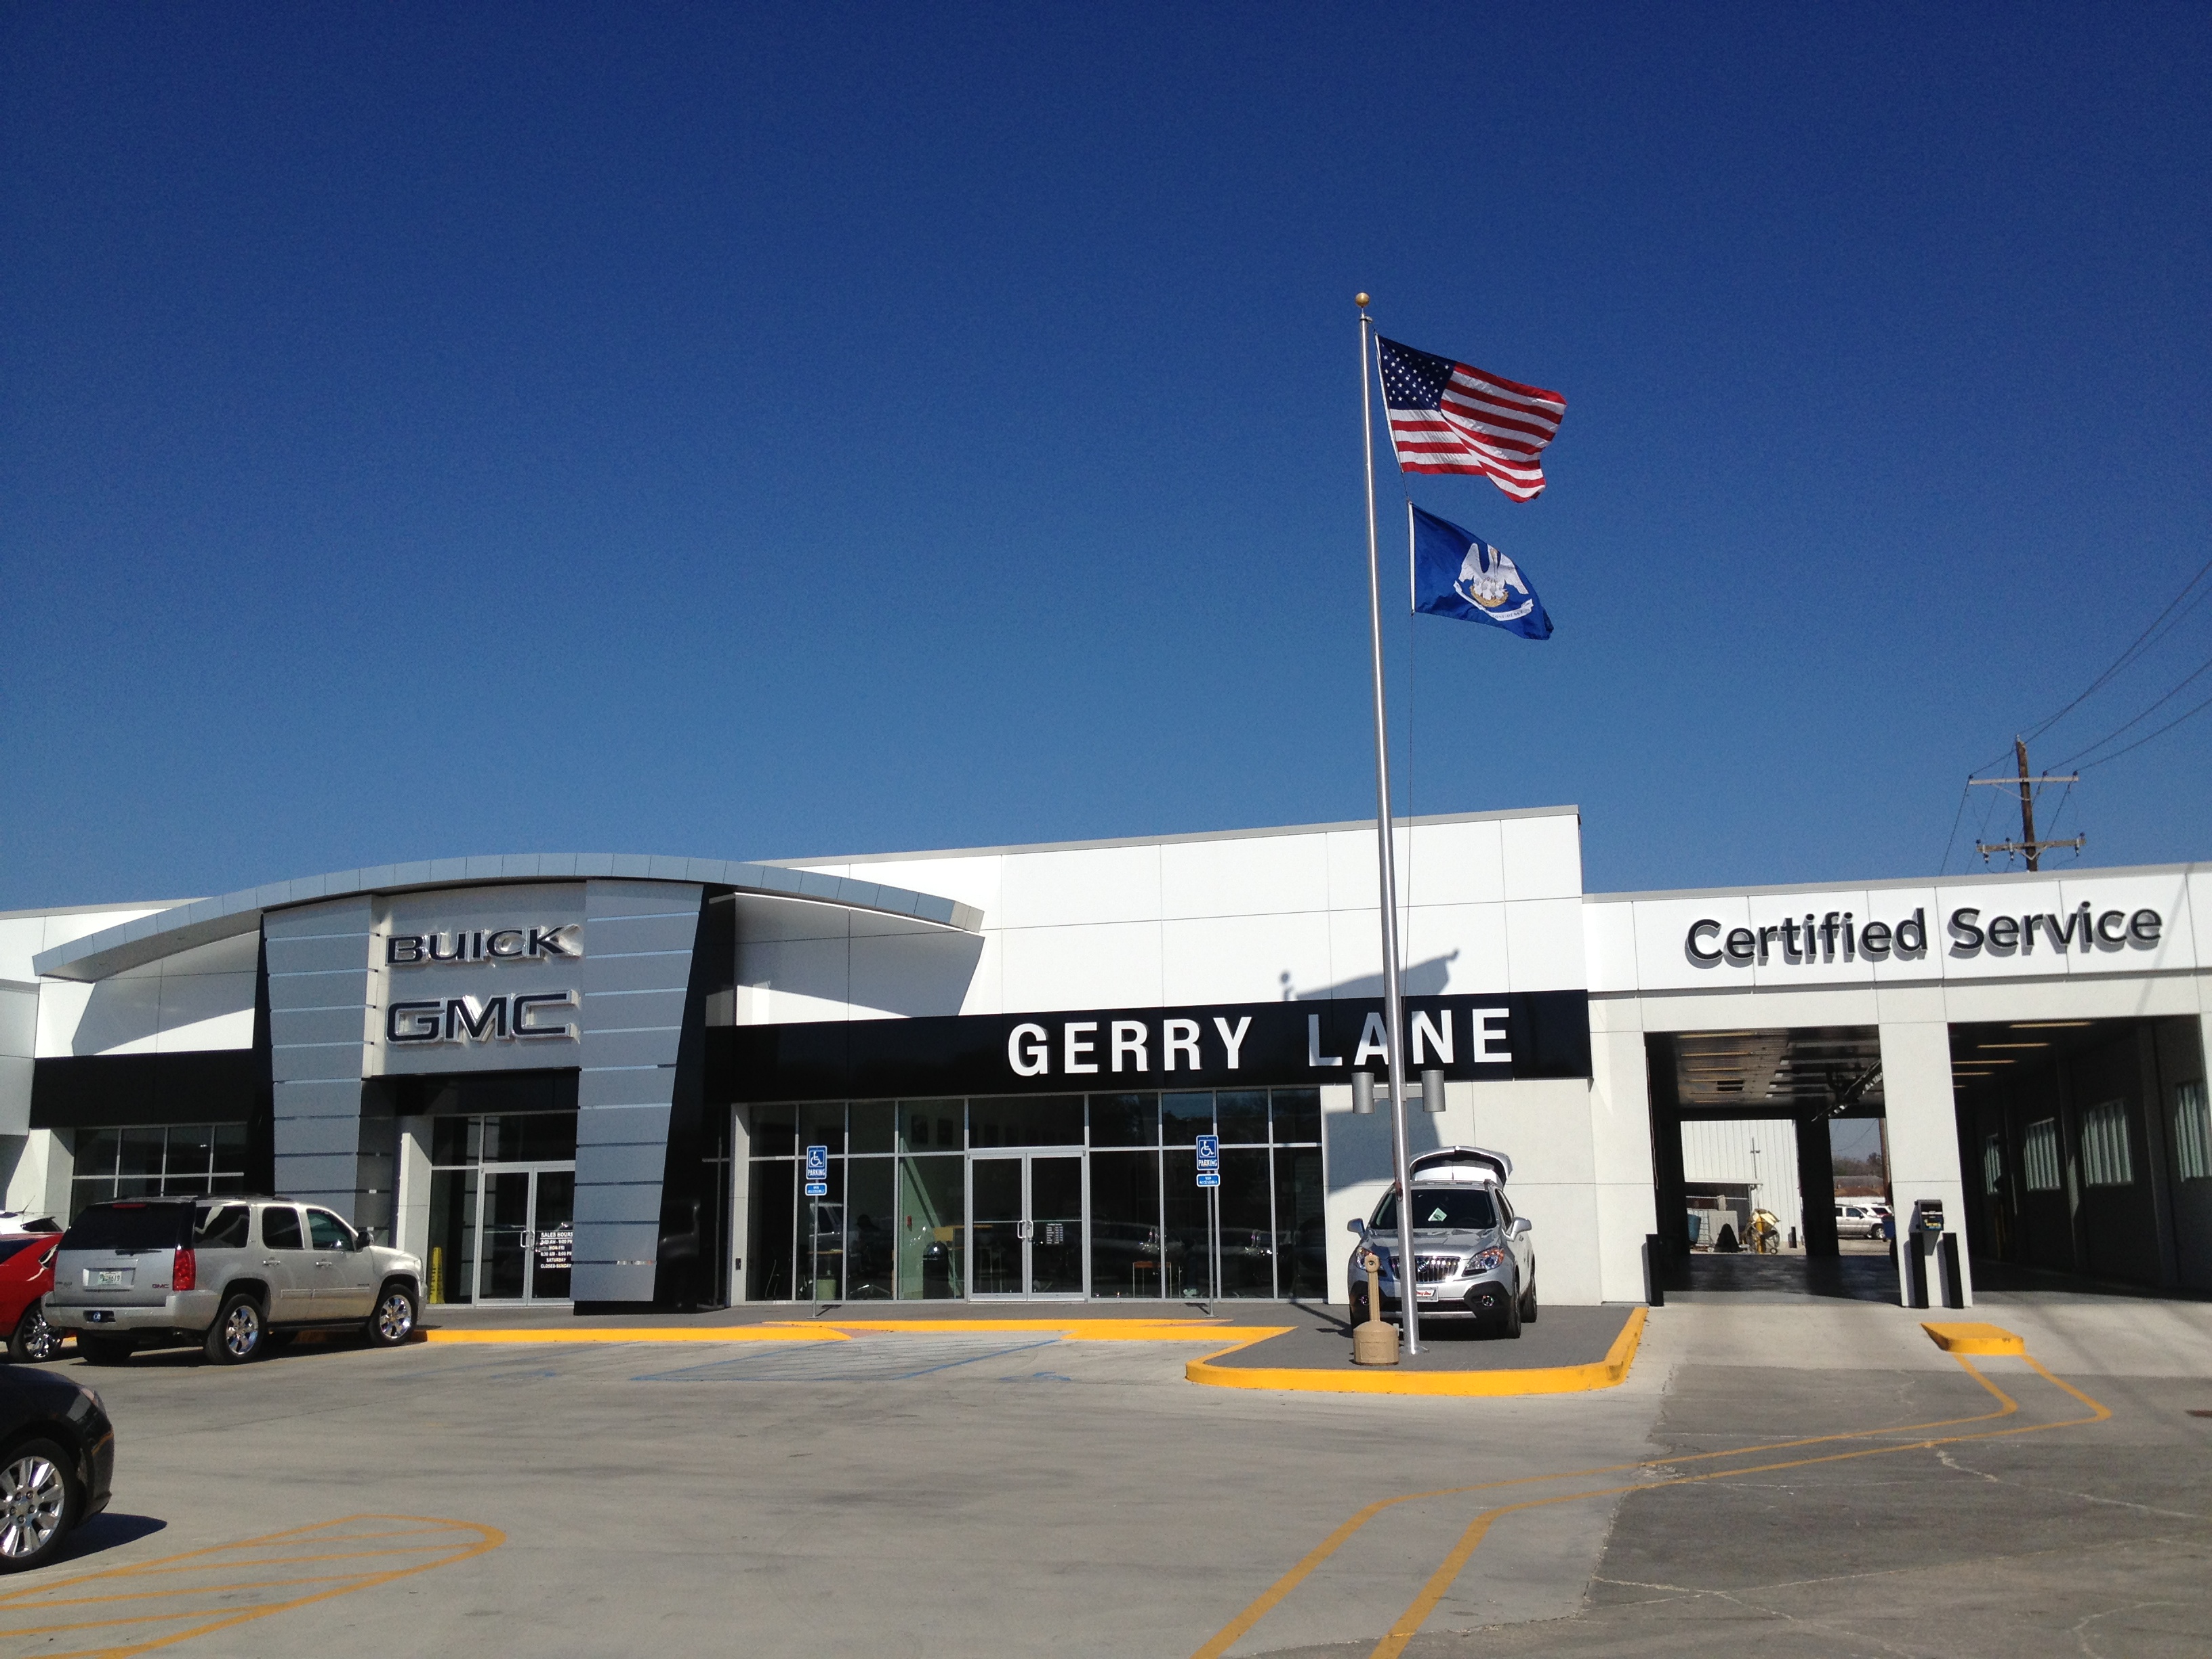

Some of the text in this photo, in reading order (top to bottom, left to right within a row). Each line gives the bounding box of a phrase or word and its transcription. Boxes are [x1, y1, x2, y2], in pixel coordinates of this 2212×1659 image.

[386, 924, 581, 966] BUICK
[1685, 901, 2162, 960] Certified Service
[386, 989, 577, 1044] GMC
[1008, 1008, 1513, 1076] GERRY LANE
